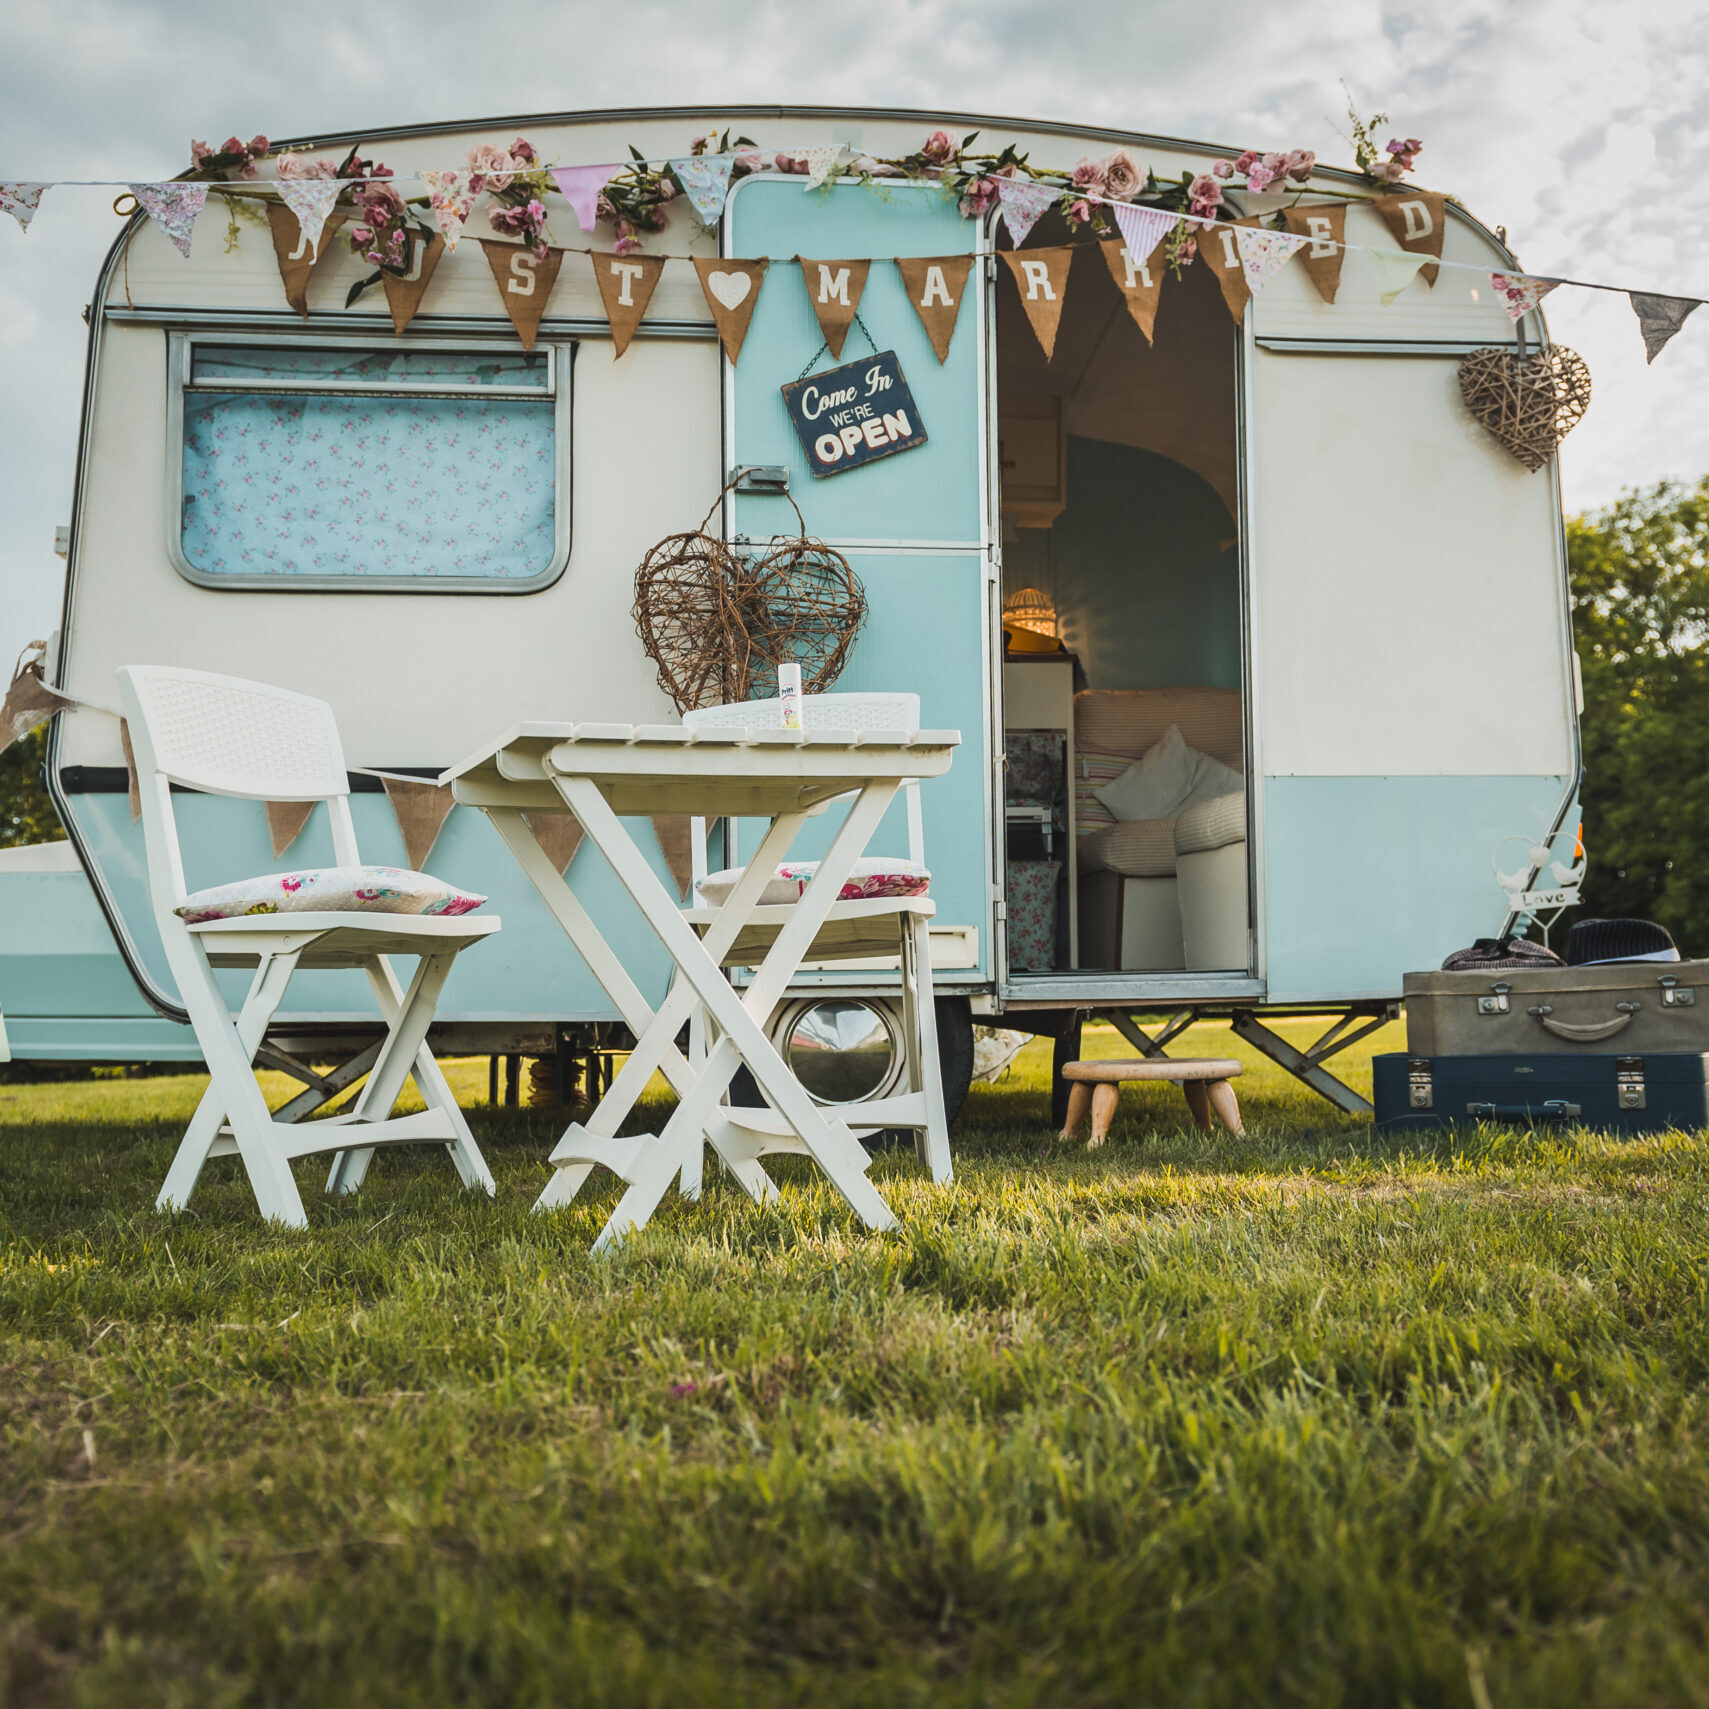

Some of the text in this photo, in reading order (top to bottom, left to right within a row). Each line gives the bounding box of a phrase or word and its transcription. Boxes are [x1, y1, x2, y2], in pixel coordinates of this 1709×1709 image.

[801, 365, 894, 421] Come In
[829, 402, 875, 428] WE'RE
[814, 408, 913, 463] OPEN
[781, 686, 794, 696] Pritt
[1522, 892, 1566, 907] Love
